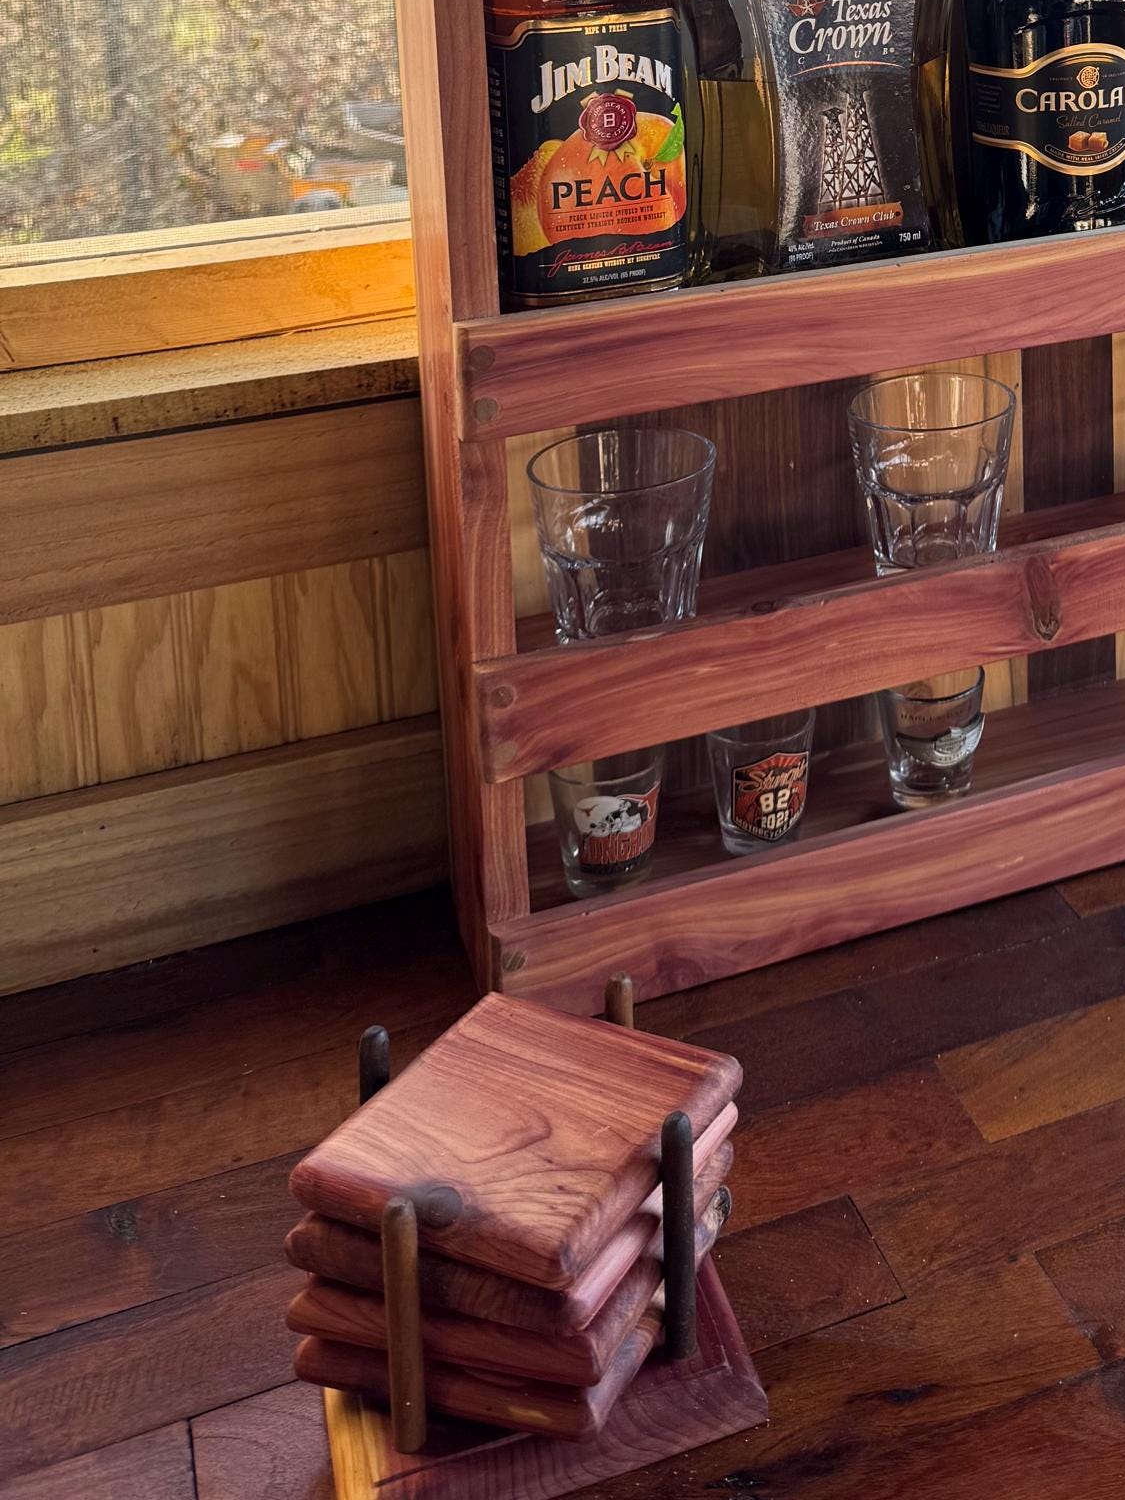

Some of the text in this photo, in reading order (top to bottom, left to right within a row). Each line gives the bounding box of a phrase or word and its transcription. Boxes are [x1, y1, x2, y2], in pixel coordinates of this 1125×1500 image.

[789, 18, 893, 54] Crown
[531, 44, 674, 114] JIM BEAM
[603, 113, 615, 128] B
[1056, 111, 1122, 129] Salted Caramel
[552, 169, 667, 209] PEACH
[813, 209, 895, 231] Texas Crown Club
[831, 238, 852, 247] Product
[859, 234, 880, 243] Canada
[899, 232, 911, 242] 750
